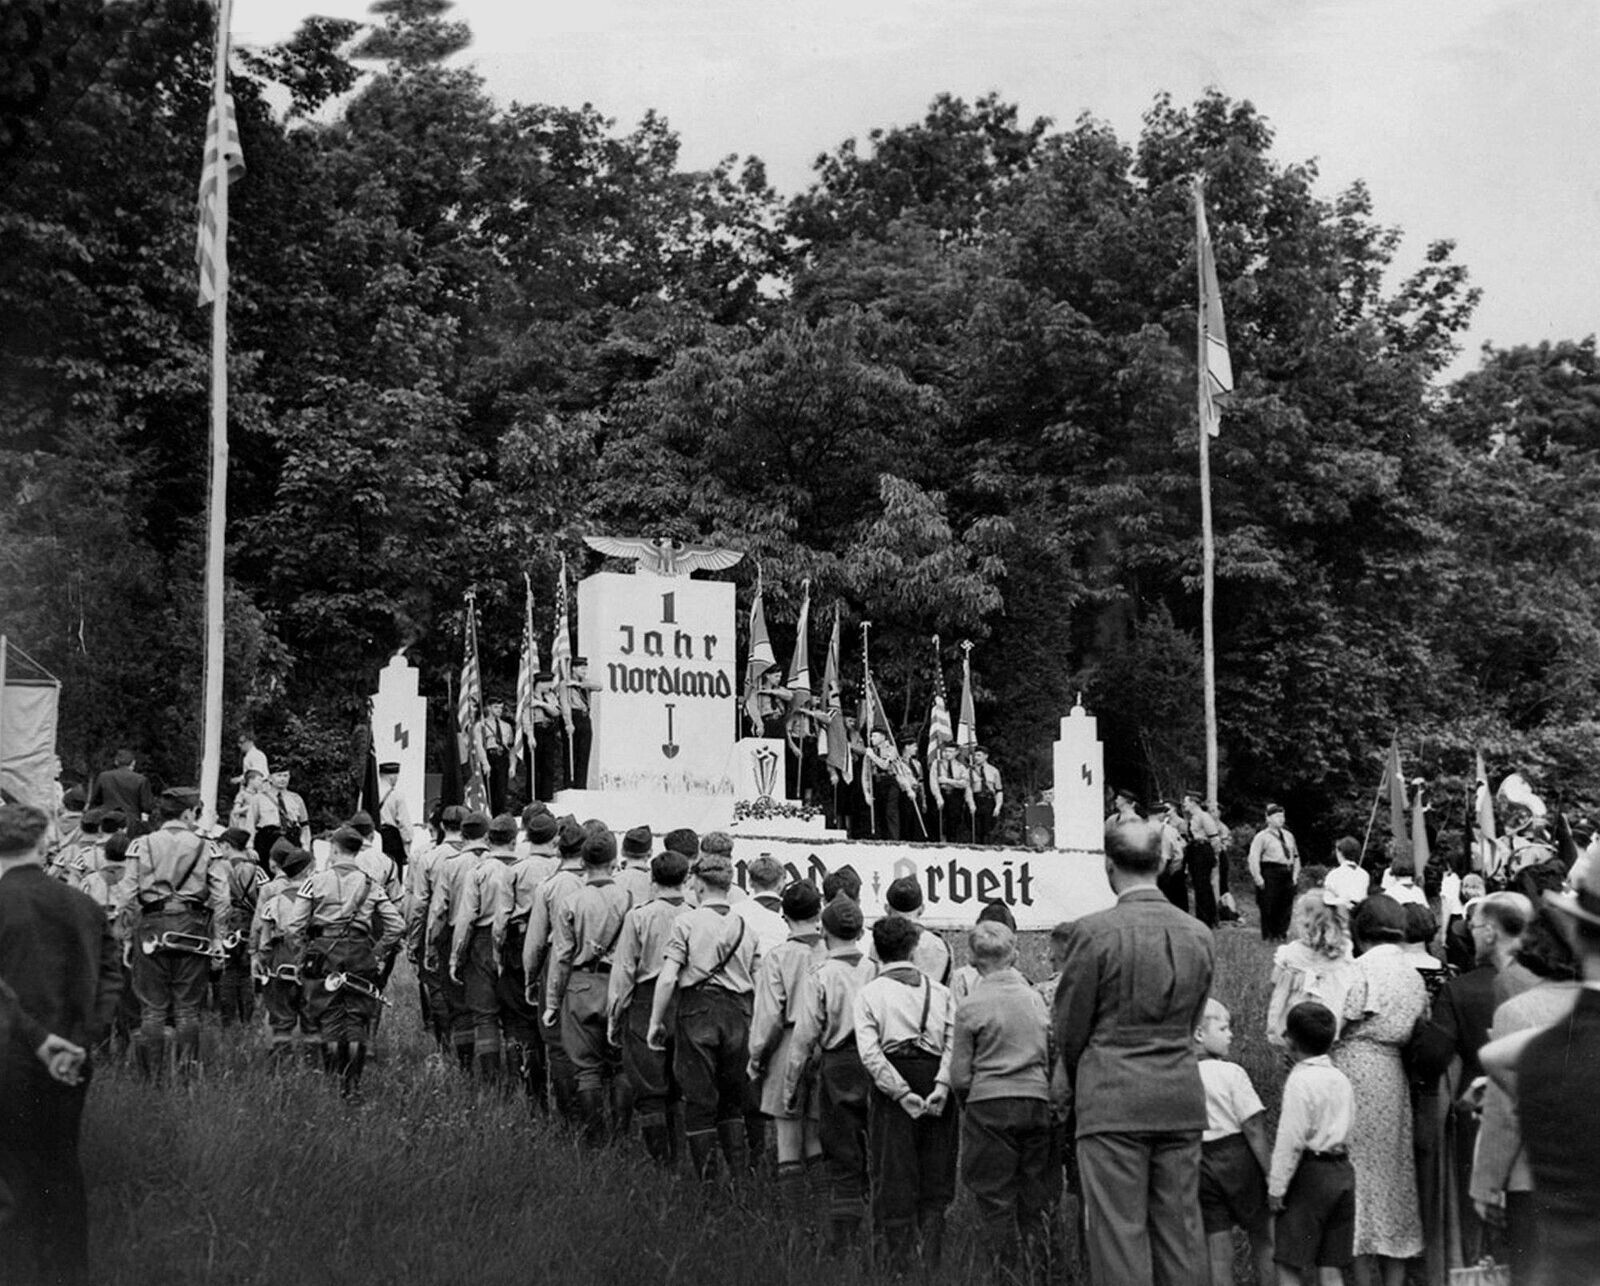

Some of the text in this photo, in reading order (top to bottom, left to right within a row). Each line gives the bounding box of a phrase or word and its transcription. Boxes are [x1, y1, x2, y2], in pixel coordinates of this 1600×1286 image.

[660, 591, 678, 624] 1
[619, 625, 718, 661] Jahr
[607, 662, 732, 699] Nordland
